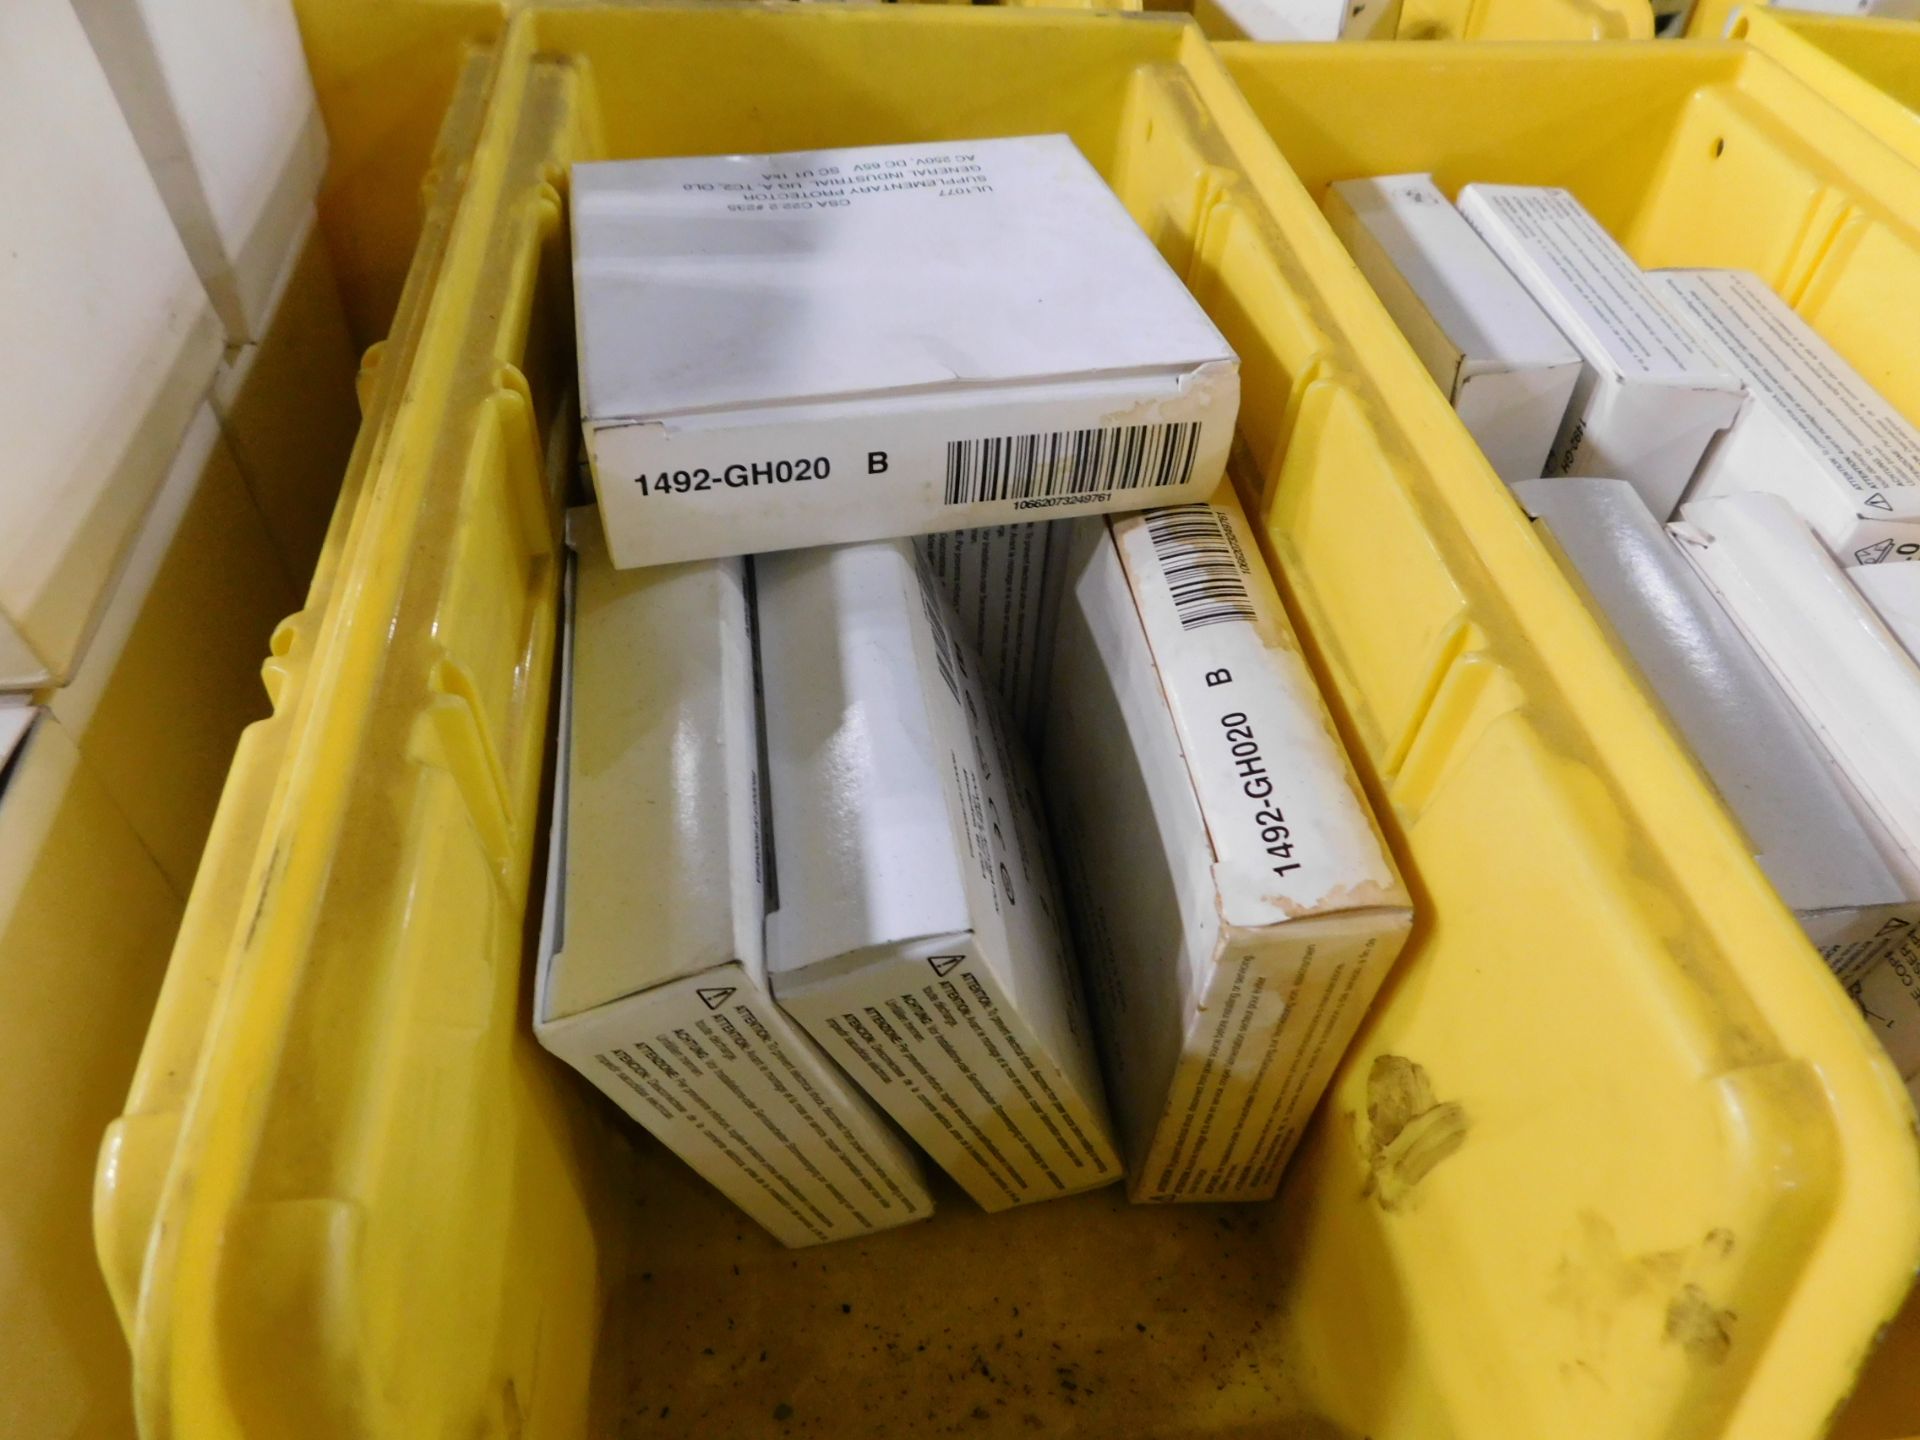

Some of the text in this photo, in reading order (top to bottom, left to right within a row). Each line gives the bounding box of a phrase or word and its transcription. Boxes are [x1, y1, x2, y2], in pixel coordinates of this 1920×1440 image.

[953, 154, 976, 163] AC
[811, 172, 904, 187] INDUSTRIAL
[912, 164, 982, 178] GENERAL
[743, 174, 987, 201] SUPPLEMENTARY PROTECTOR
[939, 185, 994, 197] UL1077
[820, 199, 850, 208] CSA
[1561, 418, 1587, 474] 1492-GH
[634, 452, 889, 498] 1492-GH020 B
[1013, 493, 1113, 512] 10662073249761
[1206, 667, 1301, 878] 1492-GH020 B
